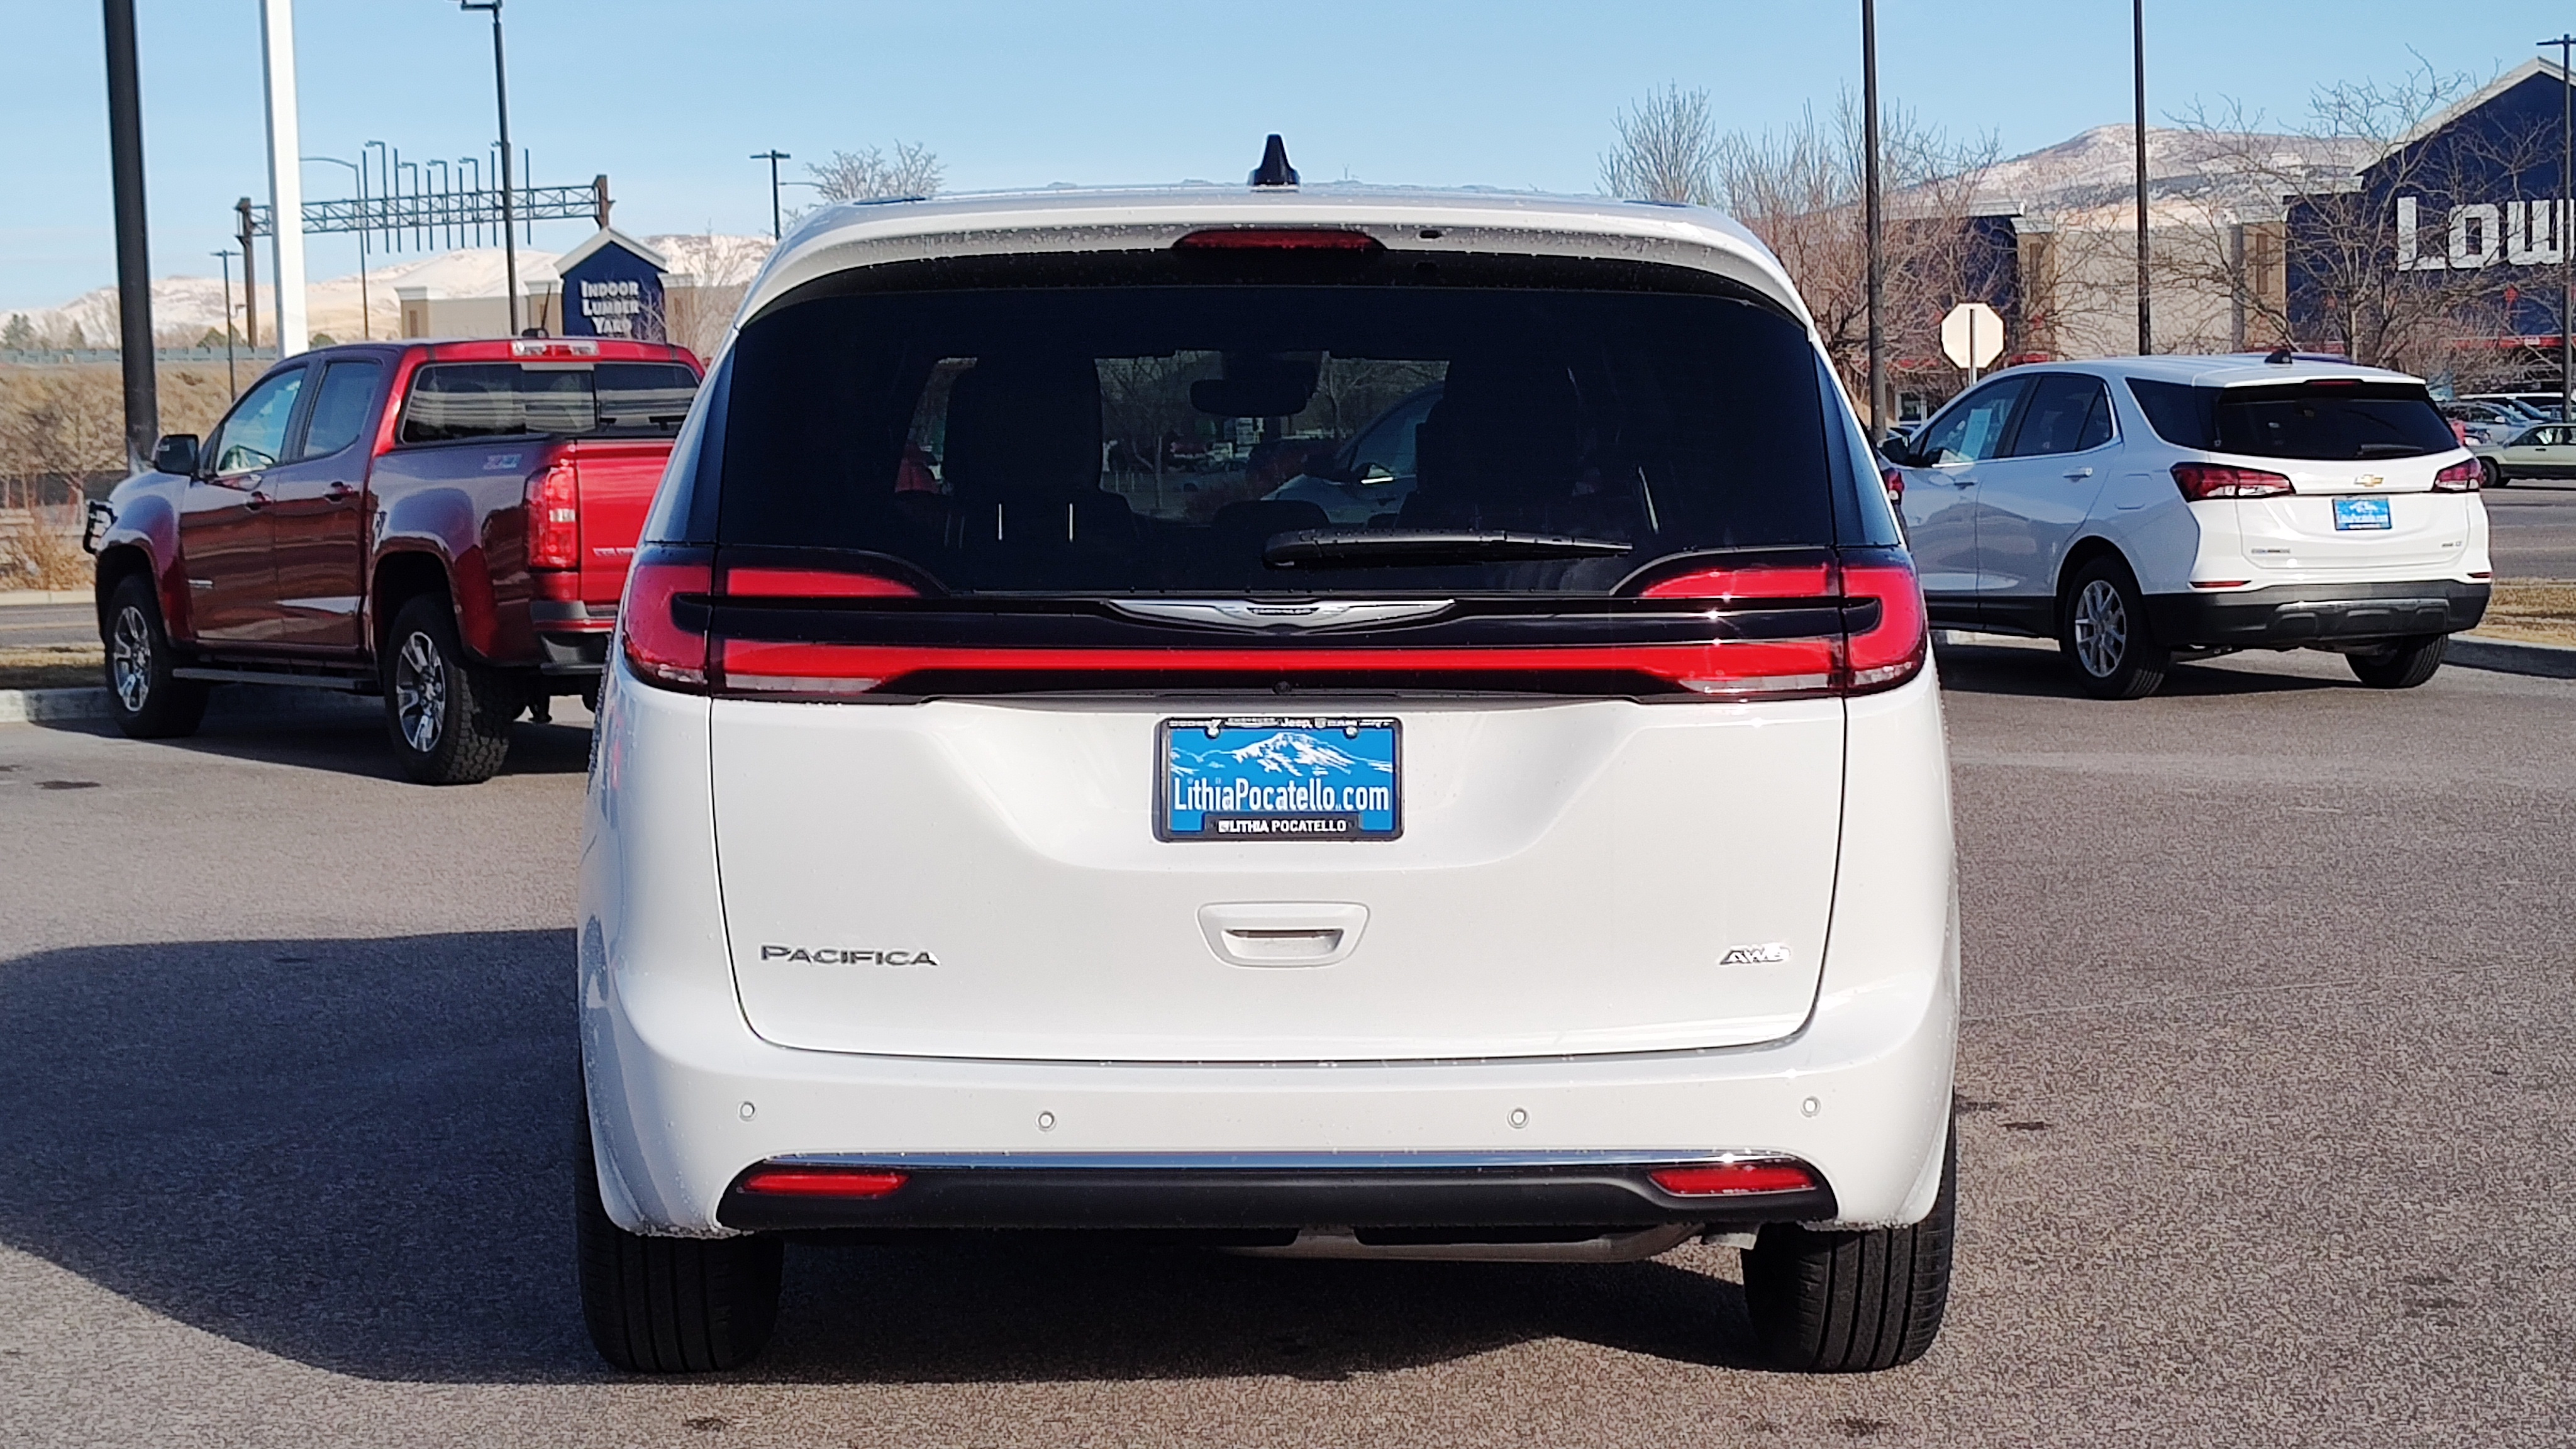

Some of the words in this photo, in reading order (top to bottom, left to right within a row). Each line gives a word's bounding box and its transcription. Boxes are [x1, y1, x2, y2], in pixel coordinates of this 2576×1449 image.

[580, 280, 639, 297] INDOOR
[1174, 777, 1389, 811] LithiaPocatello.com
[1230, 820, 1269, 833] LITHIA
[1272, 820, 1346, 832] POCATELLO
[760, 945, 941, 965] PACIFICA
